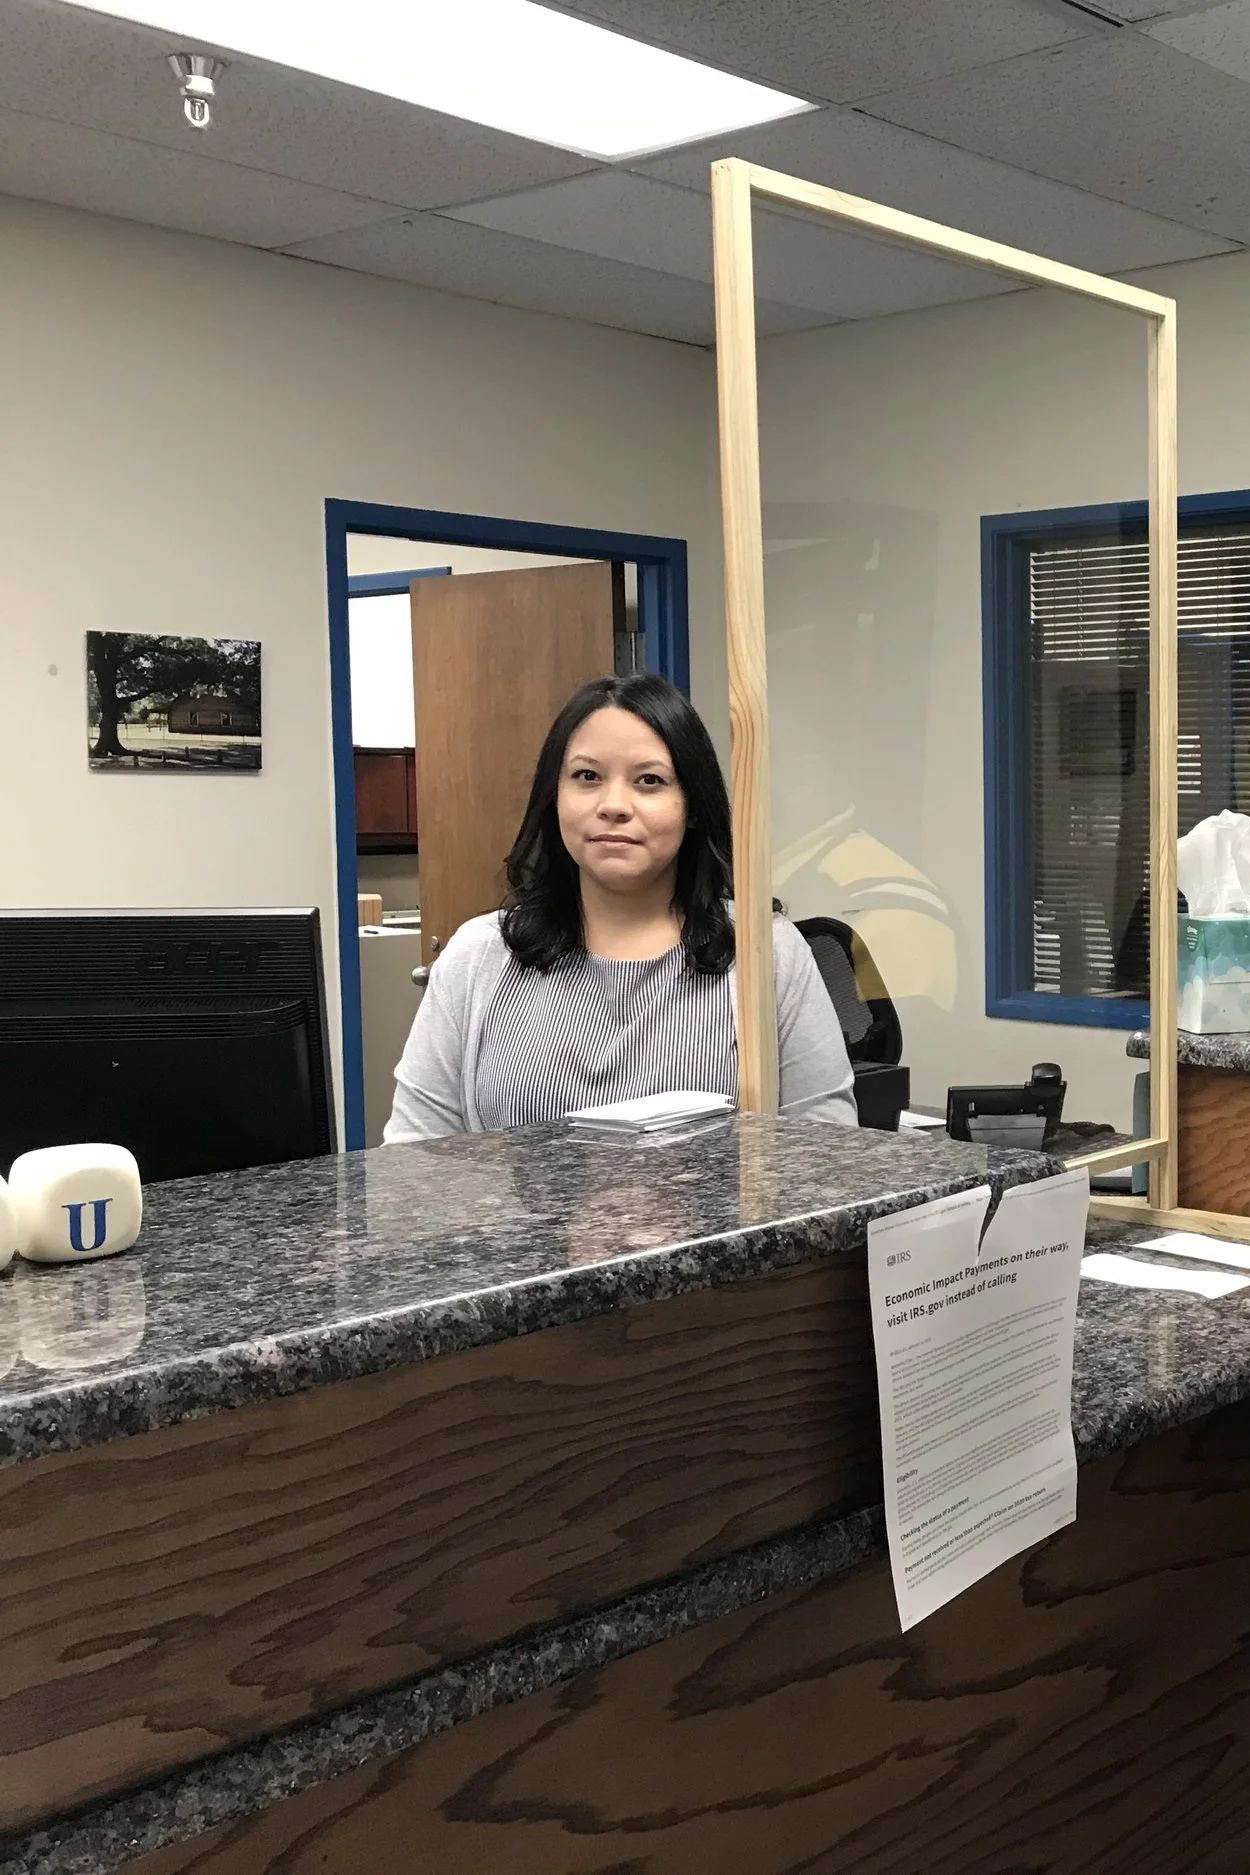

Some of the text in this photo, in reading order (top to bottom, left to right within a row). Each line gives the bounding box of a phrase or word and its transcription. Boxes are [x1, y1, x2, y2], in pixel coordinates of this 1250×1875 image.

[61, 1198, 113, 1252] U
[885, 1240, 1069, 1308] Economic Impact Payments on their way,
[896, 1249, 912, 1264] IRS
[887, 1272, 1018, 1328] visit IRS.gov instead of calling
[900, 1525, 921, 1541] Checking
[920, 1520, 928, 1529] the
[928, 1512, 943, 1525] status
[950, 1496, 970, 1513] payment
[904, 1557, 924, 1574] Payment
